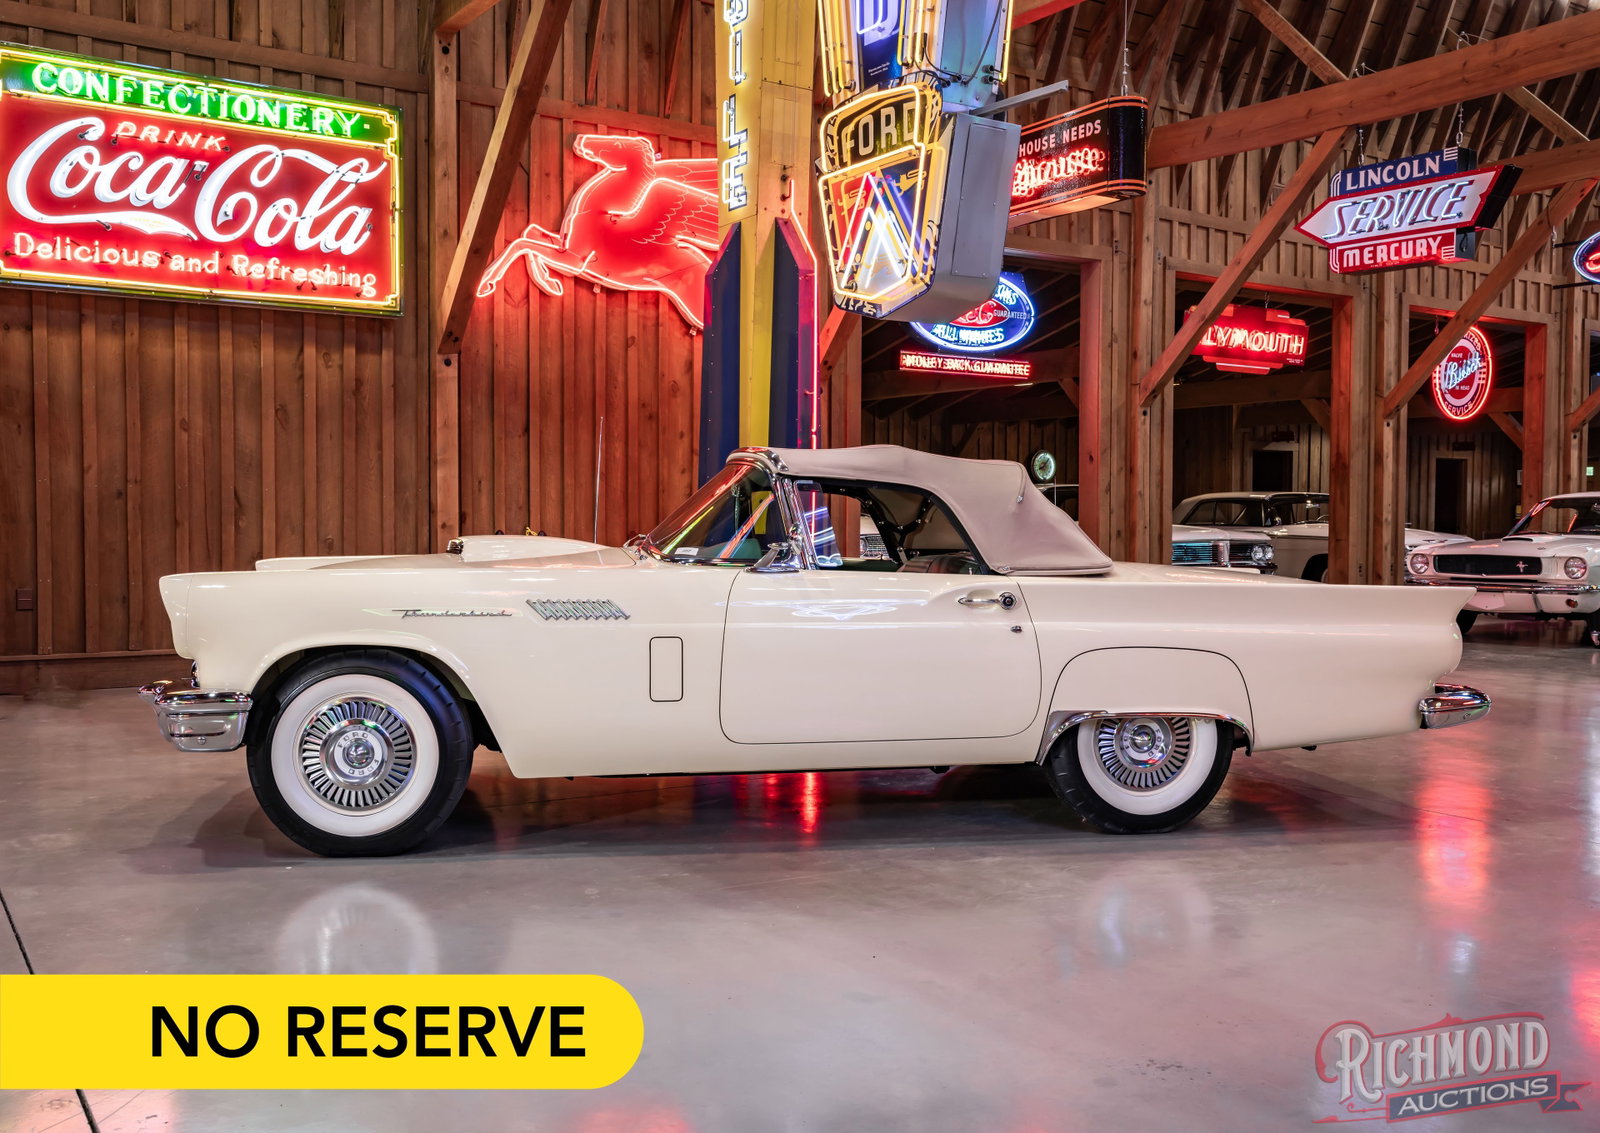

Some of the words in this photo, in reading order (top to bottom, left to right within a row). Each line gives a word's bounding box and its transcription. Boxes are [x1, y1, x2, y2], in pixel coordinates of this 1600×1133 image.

[32, 62, 361, 138] CONFECTIONERY
[111, 121, 226, 151] DRINK
[841, 101, 920, 164] FORD
[1062, 119, 1102, 144] NEEDS
[1346, 155, 1441, 191] LINCOLN
[1321, 179, 1474, 240] SERVICE
[14, 232, 162, 268] Delicious
[170, 251, 220, 274] and
[232, 254, 377, 298] Refreshing
[1343, 236, 1442, 268] MERCURY
[1200, 324, 1305, 355] LYMOUTH
[1444, 401, 1473, 415] SERVICE
